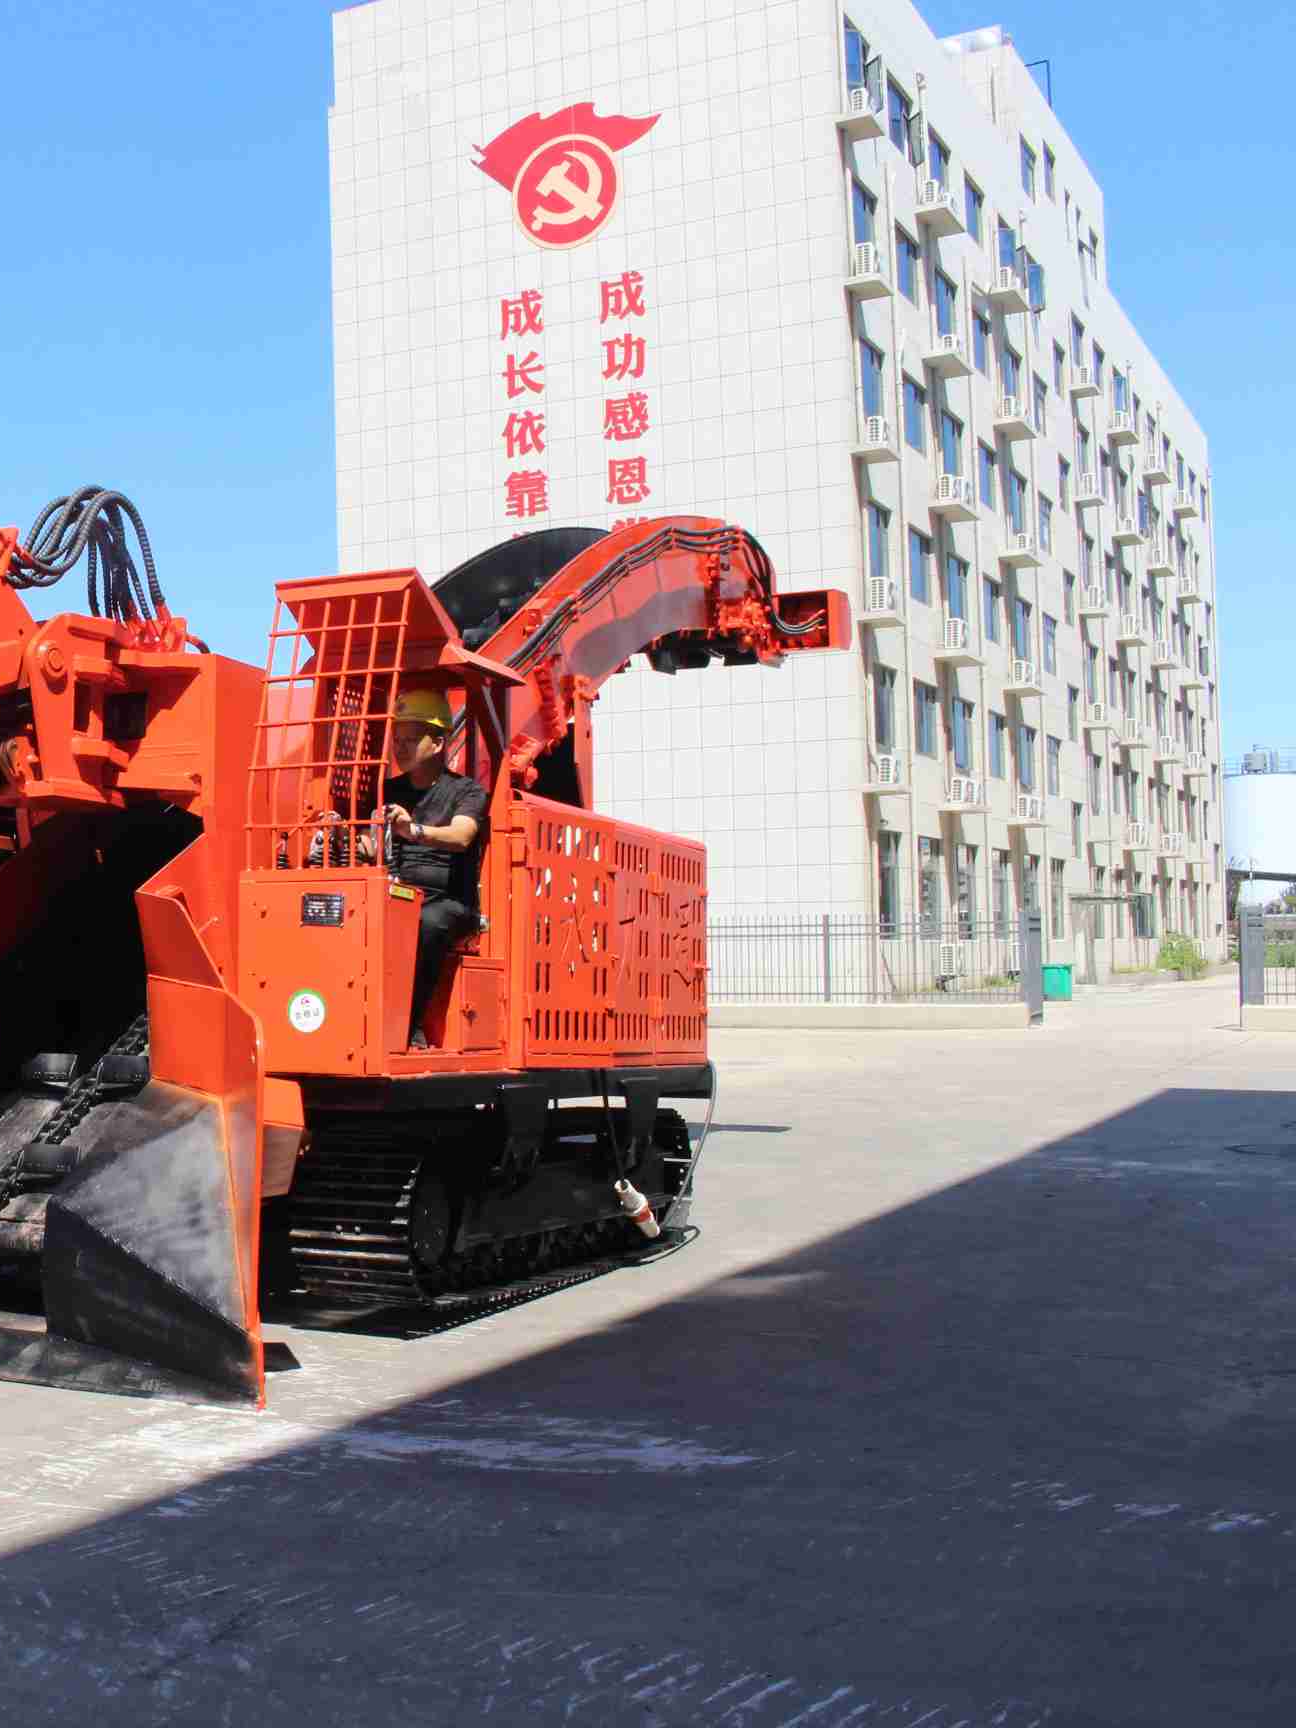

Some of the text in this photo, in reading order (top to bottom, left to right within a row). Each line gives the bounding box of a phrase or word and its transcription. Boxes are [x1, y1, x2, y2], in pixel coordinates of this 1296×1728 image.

[500, 289, 548, 536] 成长依靠
[600, 271, 650, 530] 成功感恩
